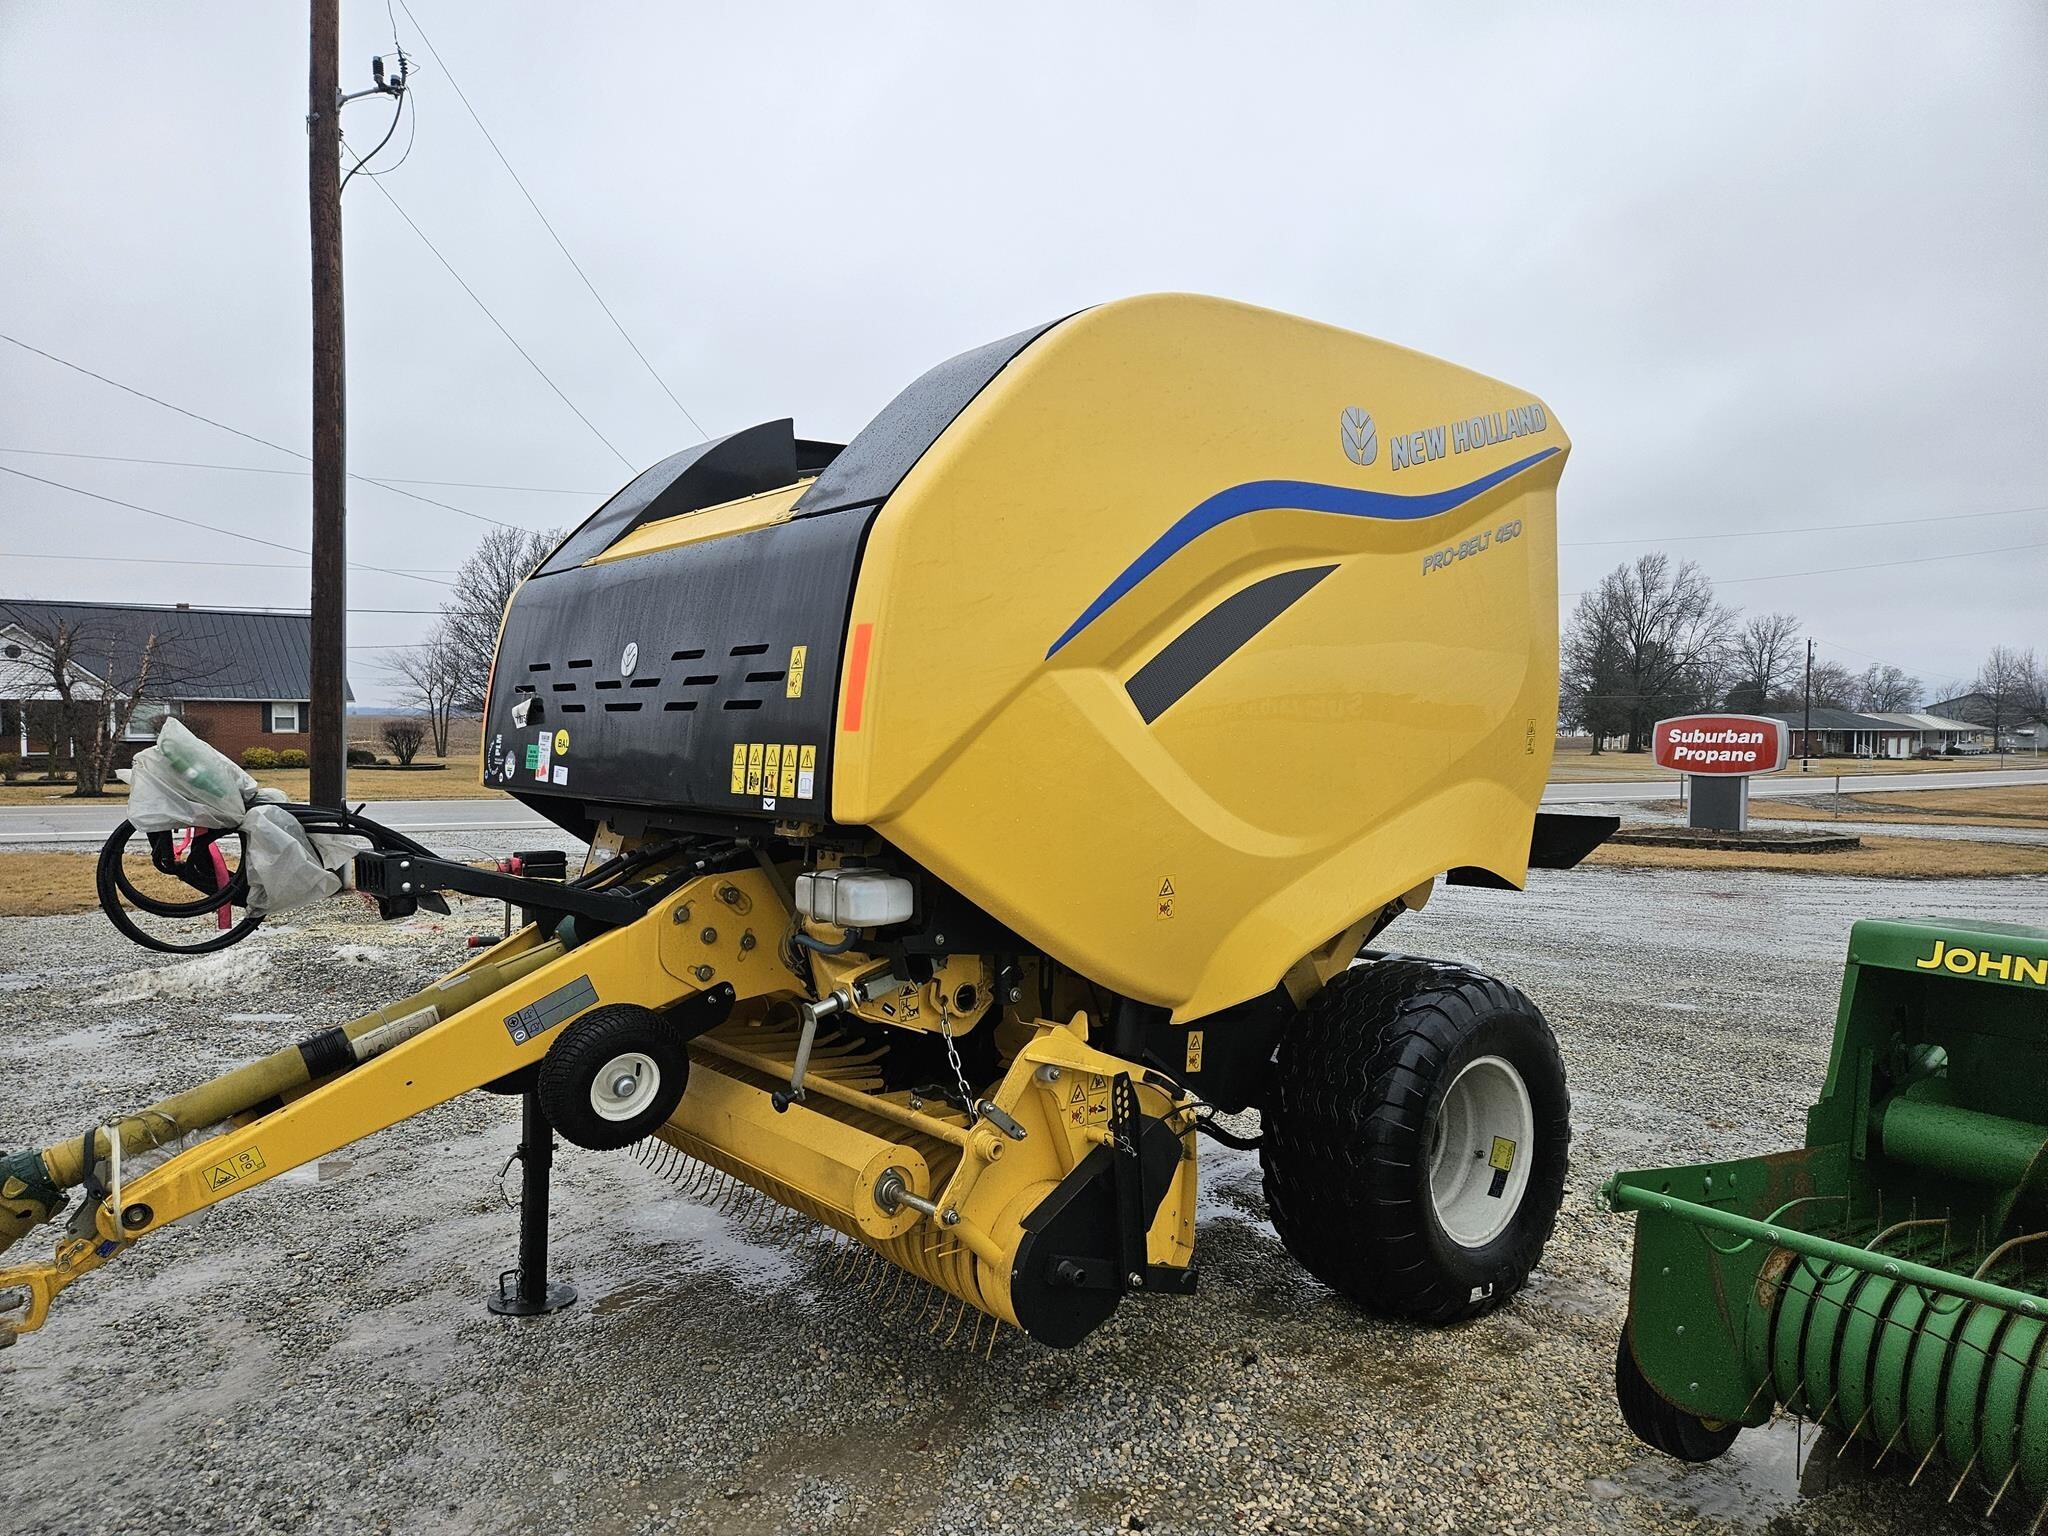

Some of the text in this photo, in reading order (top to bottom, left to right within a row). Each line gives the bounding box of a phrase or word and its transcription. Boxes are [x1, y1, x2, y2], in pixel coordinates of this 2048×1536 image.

[1390, 403, 1546, 471] NEW HOLLAND
[1422, 519, 1522, 576] PRO-BELT 450
[1669, 729, 1764, 744] Suburban
[1674, 747, 1757, 764] Propane
[1916, 940, 2048, 985] JOHN
